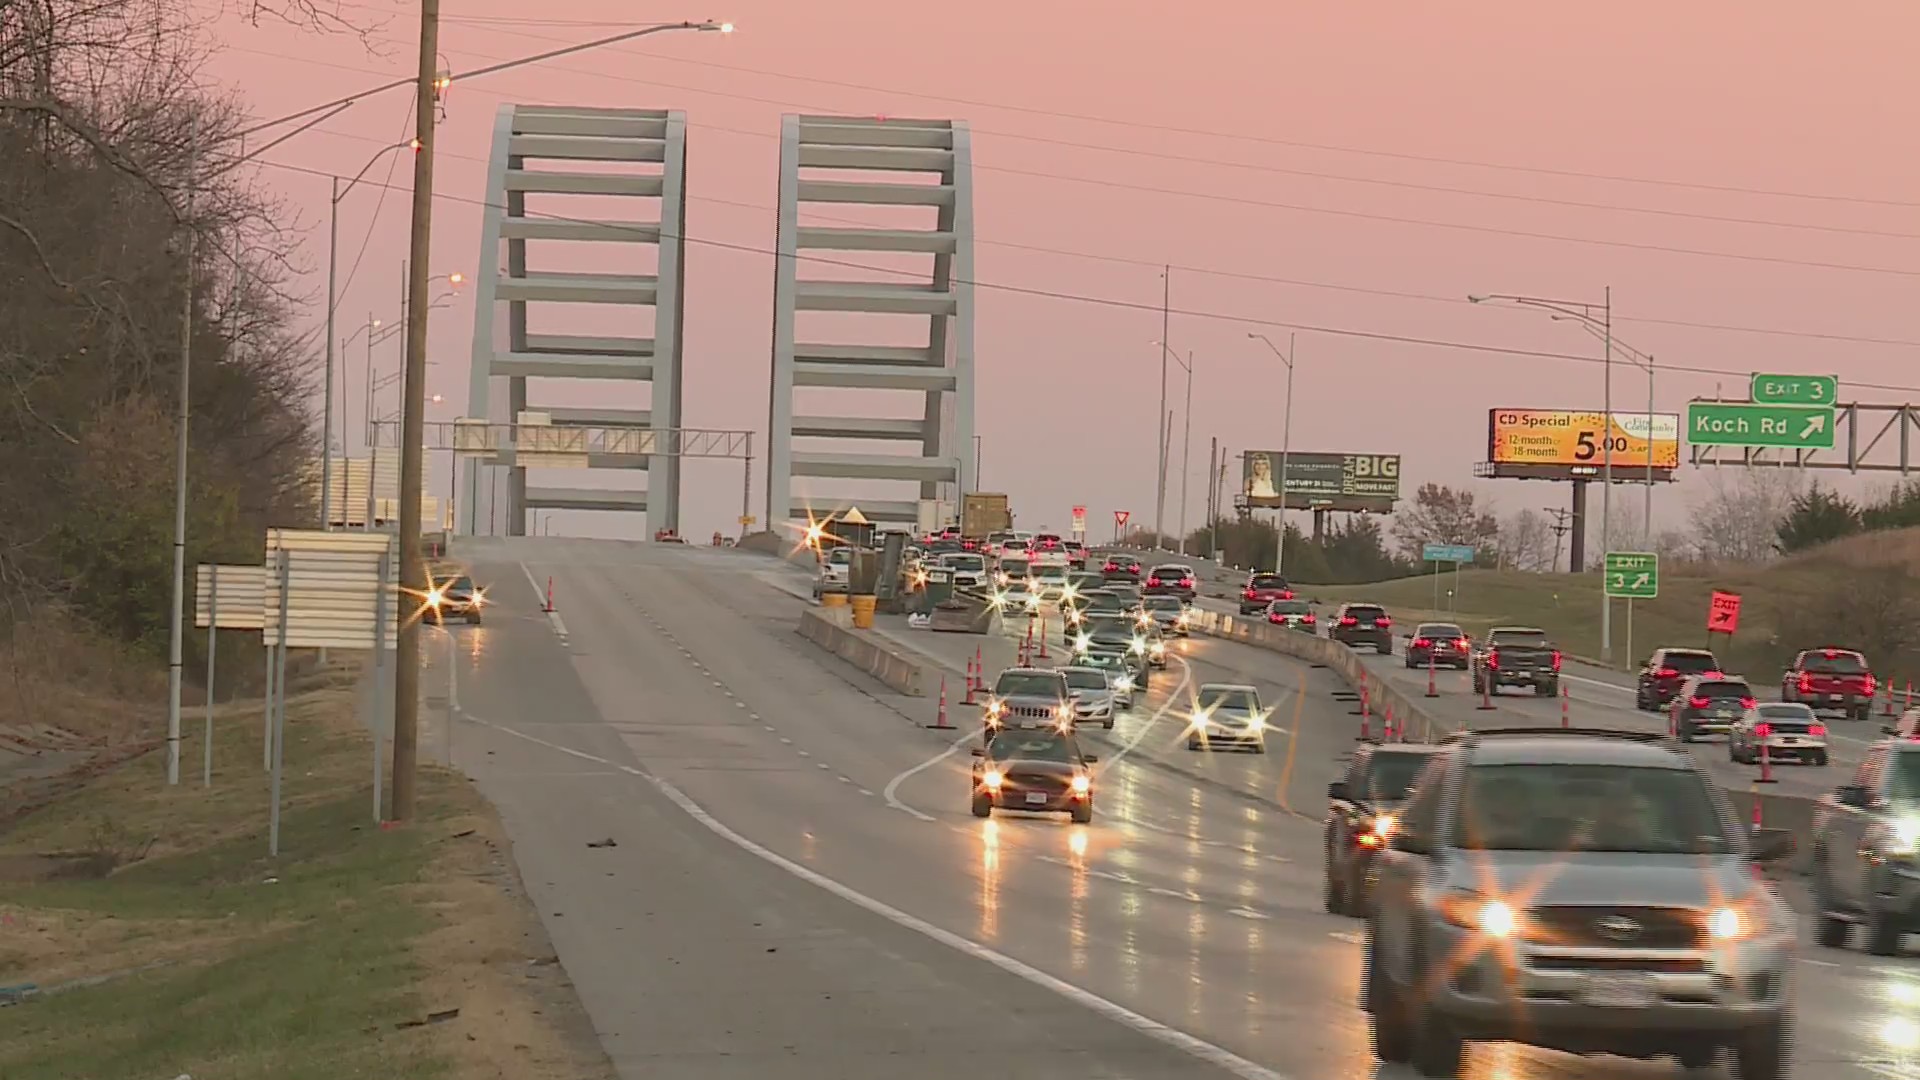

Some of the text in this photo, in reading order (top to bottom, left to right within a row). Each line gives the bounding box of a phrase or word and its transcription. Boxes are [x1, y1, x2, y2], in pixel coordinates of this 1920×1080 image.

[1809, 381, 1824, 399] 3
[1499, 414, 1570, 428] CD Special
[1696, 415, 1787, 434] Koch Rd
[1509, 434, 1552, 445] 12-month
[1513, 446, 1558, 457] 18-month
[1355, 456, 1398, 477] BIG
[1343, 456, 1355, 495] DREAM
[1616, 557, 1646, 569] EXIT
[1612, 572, 1625, 588] 3
[1714, 597, 1738, 611] EXIT
